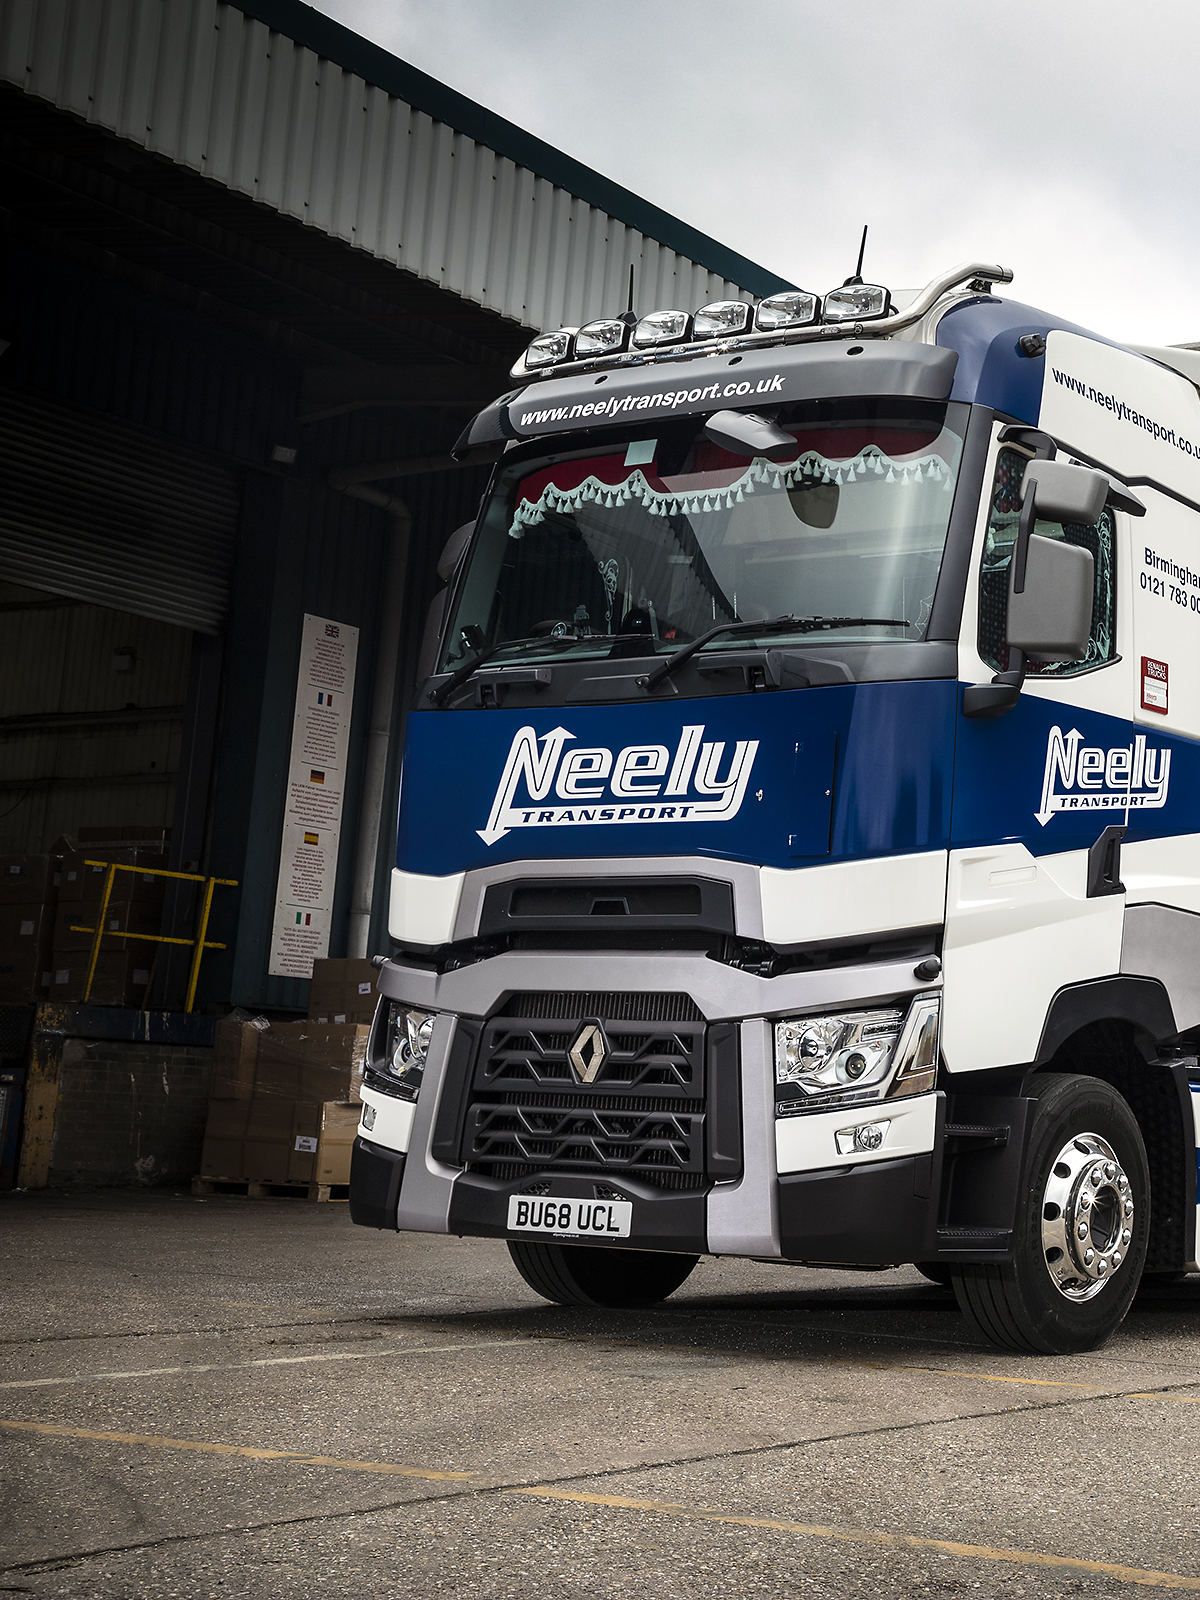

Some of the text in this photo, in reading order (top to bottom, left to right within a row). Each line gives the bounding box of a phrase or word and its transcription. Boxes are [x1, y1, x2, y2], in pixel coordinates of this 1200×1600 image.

[520, 375, 786, 426] www.neelytransport.co.uk
[1140, 572, 1164, 597] 0121
[1169, 584, 1188, 607] 783
[480, 725, 759, 835] Neely
[1037, 725, 1171, 818] Neely
[520, 806, 695, 824] TRANSPORT
[1061, 796, 1147, 808] TRANSPORT
[516, 1201, 620, 1232] BU68 UCL
